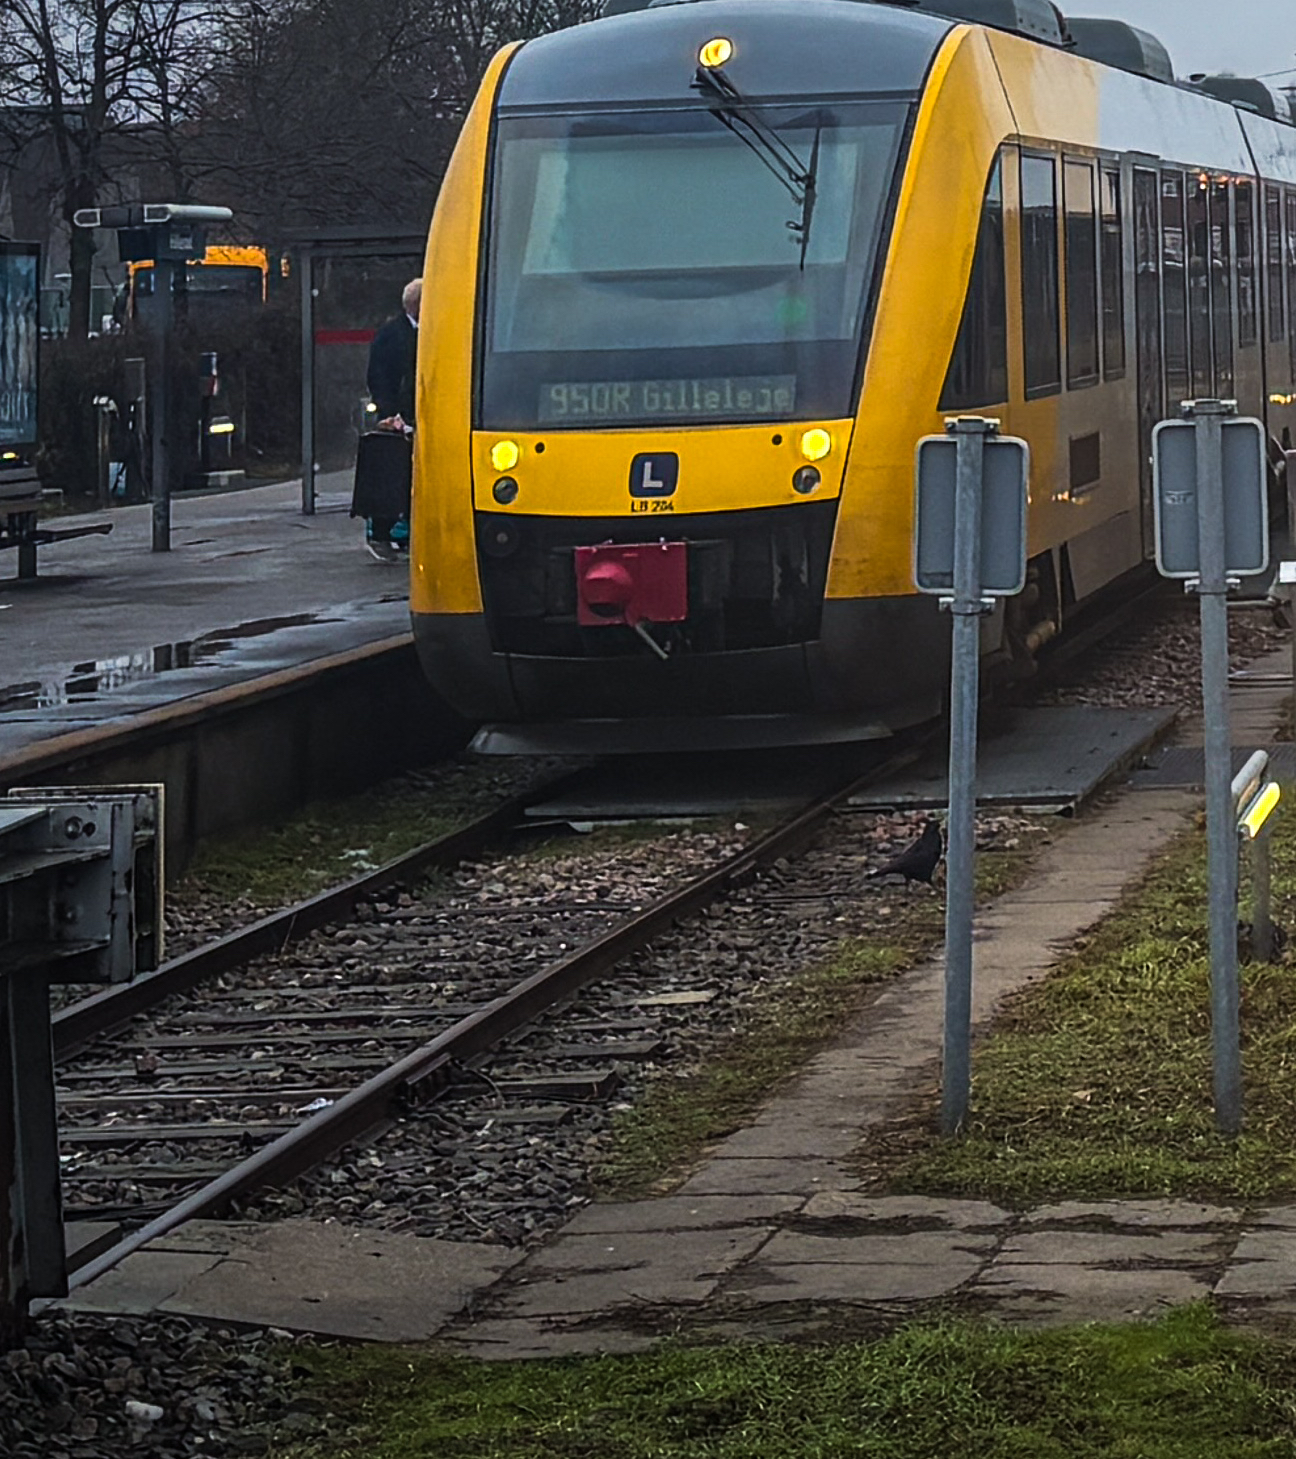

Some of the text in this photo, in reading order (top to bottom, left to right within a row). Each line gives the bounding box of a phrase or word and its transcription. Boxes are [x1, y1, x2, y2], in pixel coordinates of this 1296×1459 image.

[550, 383, 631, 415] 950R
[642, 461, 663, 488] L
[631, 500, 648, 513] LB
